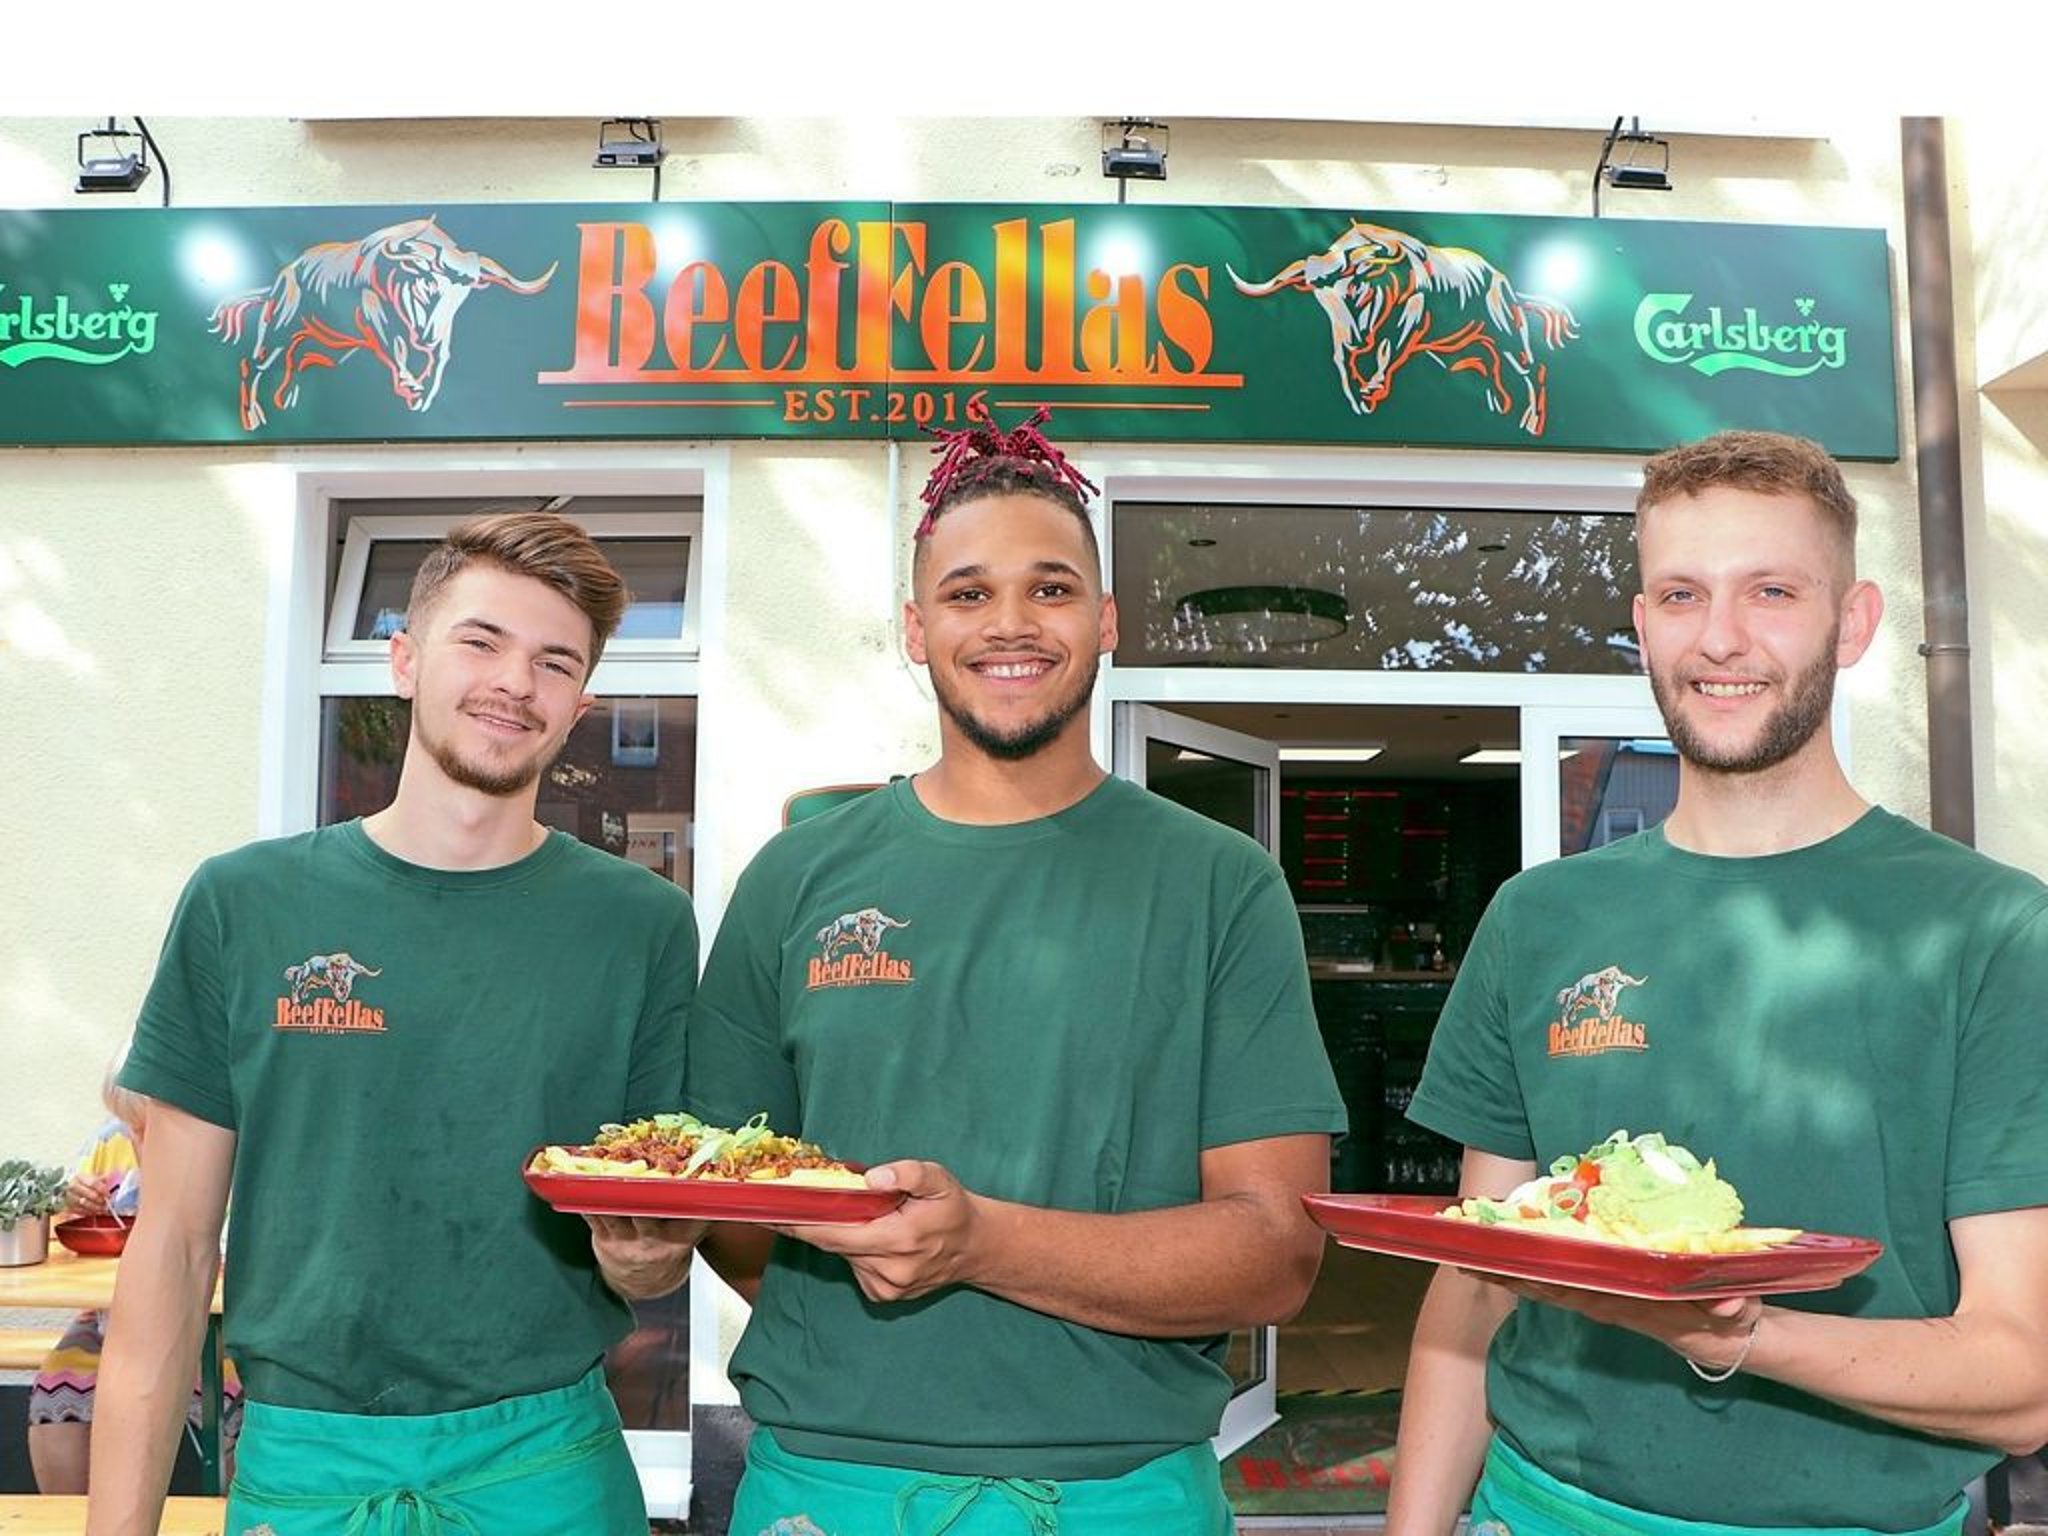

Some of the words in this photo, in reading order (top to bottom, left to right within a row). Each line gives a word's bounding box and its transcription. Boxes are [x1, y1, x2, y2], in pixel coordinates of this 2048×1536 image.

[0, 284, 159, 354] rlsberg
[575, 217, 1215, 384] BeefFellas
[1633, 293, 1847, 370] Carlsberg
[276, 996, 385, 1030] BeefFellas
